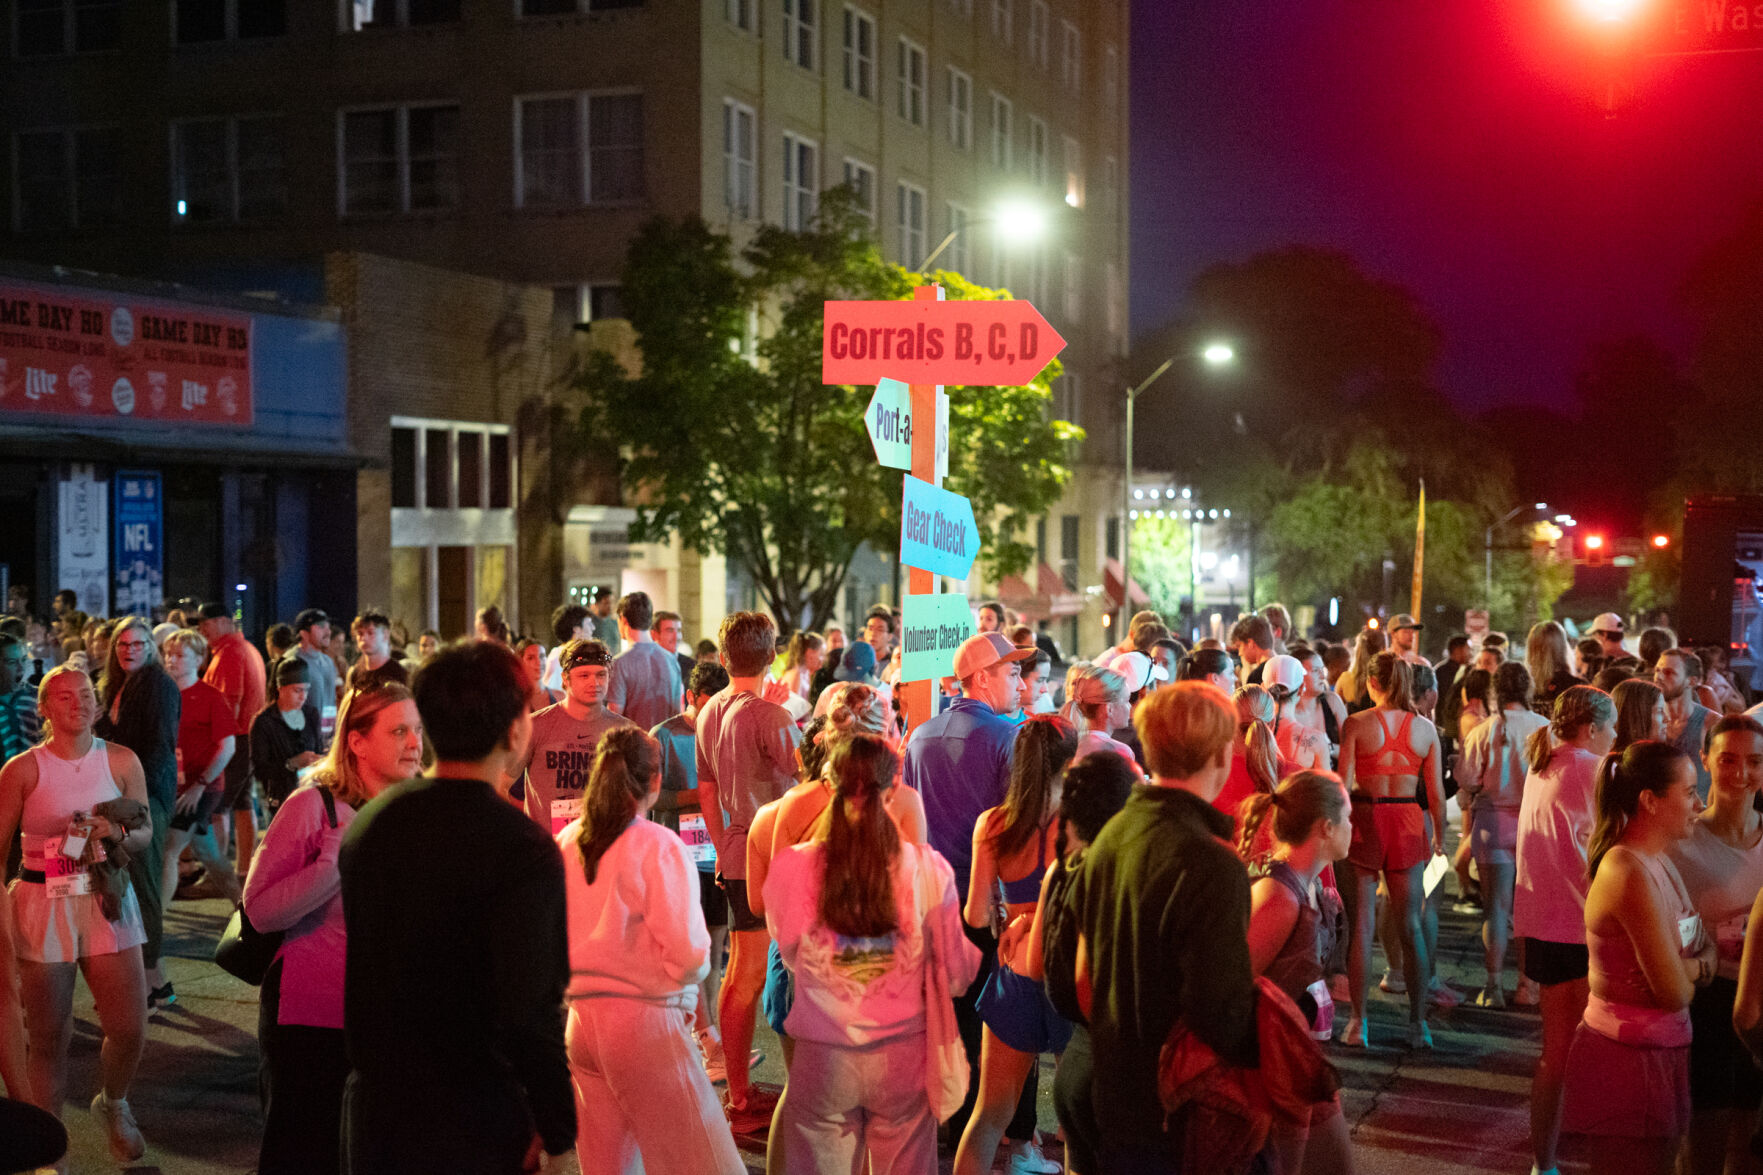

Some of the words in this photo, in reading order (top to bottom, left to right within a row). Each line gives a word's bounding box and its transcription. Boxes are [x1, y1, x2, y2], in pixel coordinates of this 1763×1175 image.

[38, 303, 73, 332] DAY
[80, 310, 103, 335] HQ
[141, 315, 188, 343] GAME
[193, 321, 222, 347] DAY
[830, 322, 945, 361] Corrals
[954, 322, 1039, 366] B,C,D
[25, 366, 58, 400] Lite
[182, 379, 208, 411] Lite
[124, 523, 154, 552] NFL
[906, 500, 932, 546] Gear
[933, 510, 967, 558] Check
[904, 626, 938, 654] Volunteer
[939, 621, 970, 650] Check-in
